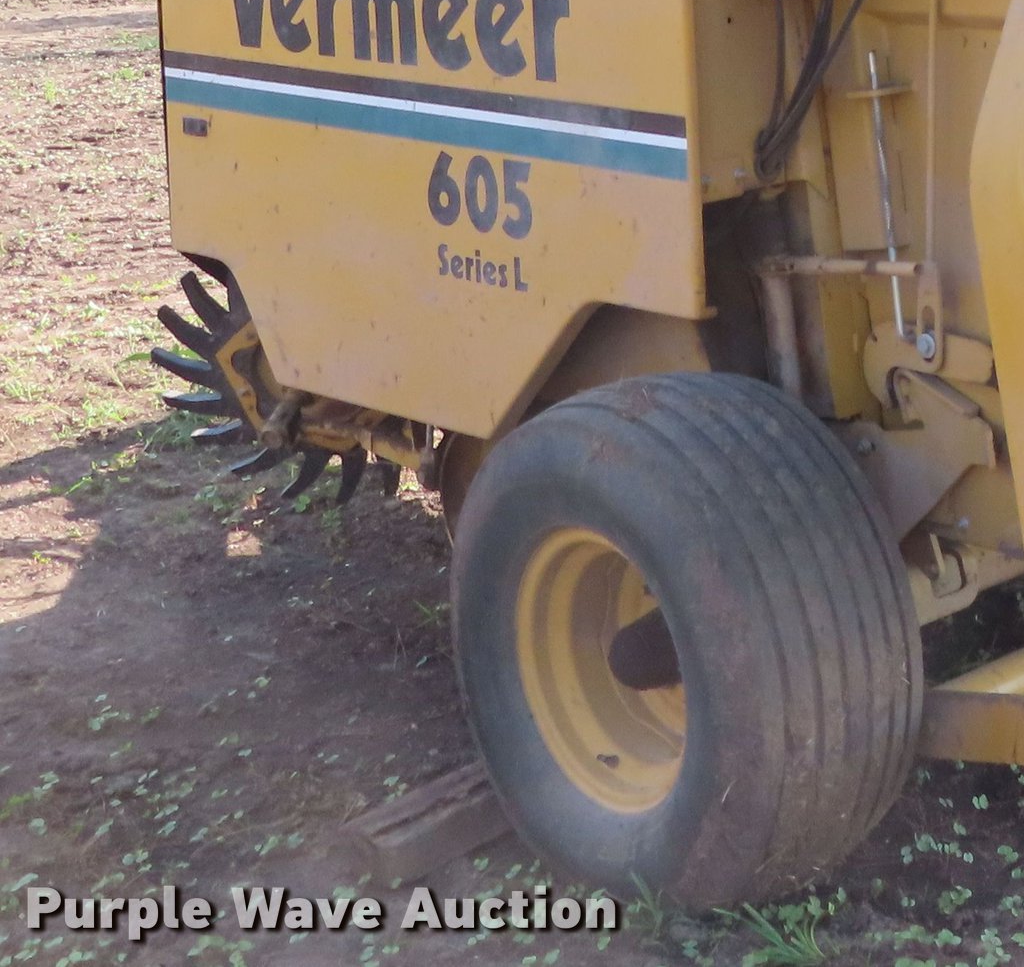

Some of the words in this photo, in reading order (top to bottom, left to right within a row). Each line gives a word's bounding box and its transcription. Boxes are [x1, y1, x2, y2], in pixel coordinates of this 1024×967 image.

[428, 150, 533, 239] 605
[438, 243, 508, 288] Series
[514, 256, 529, 292] L
